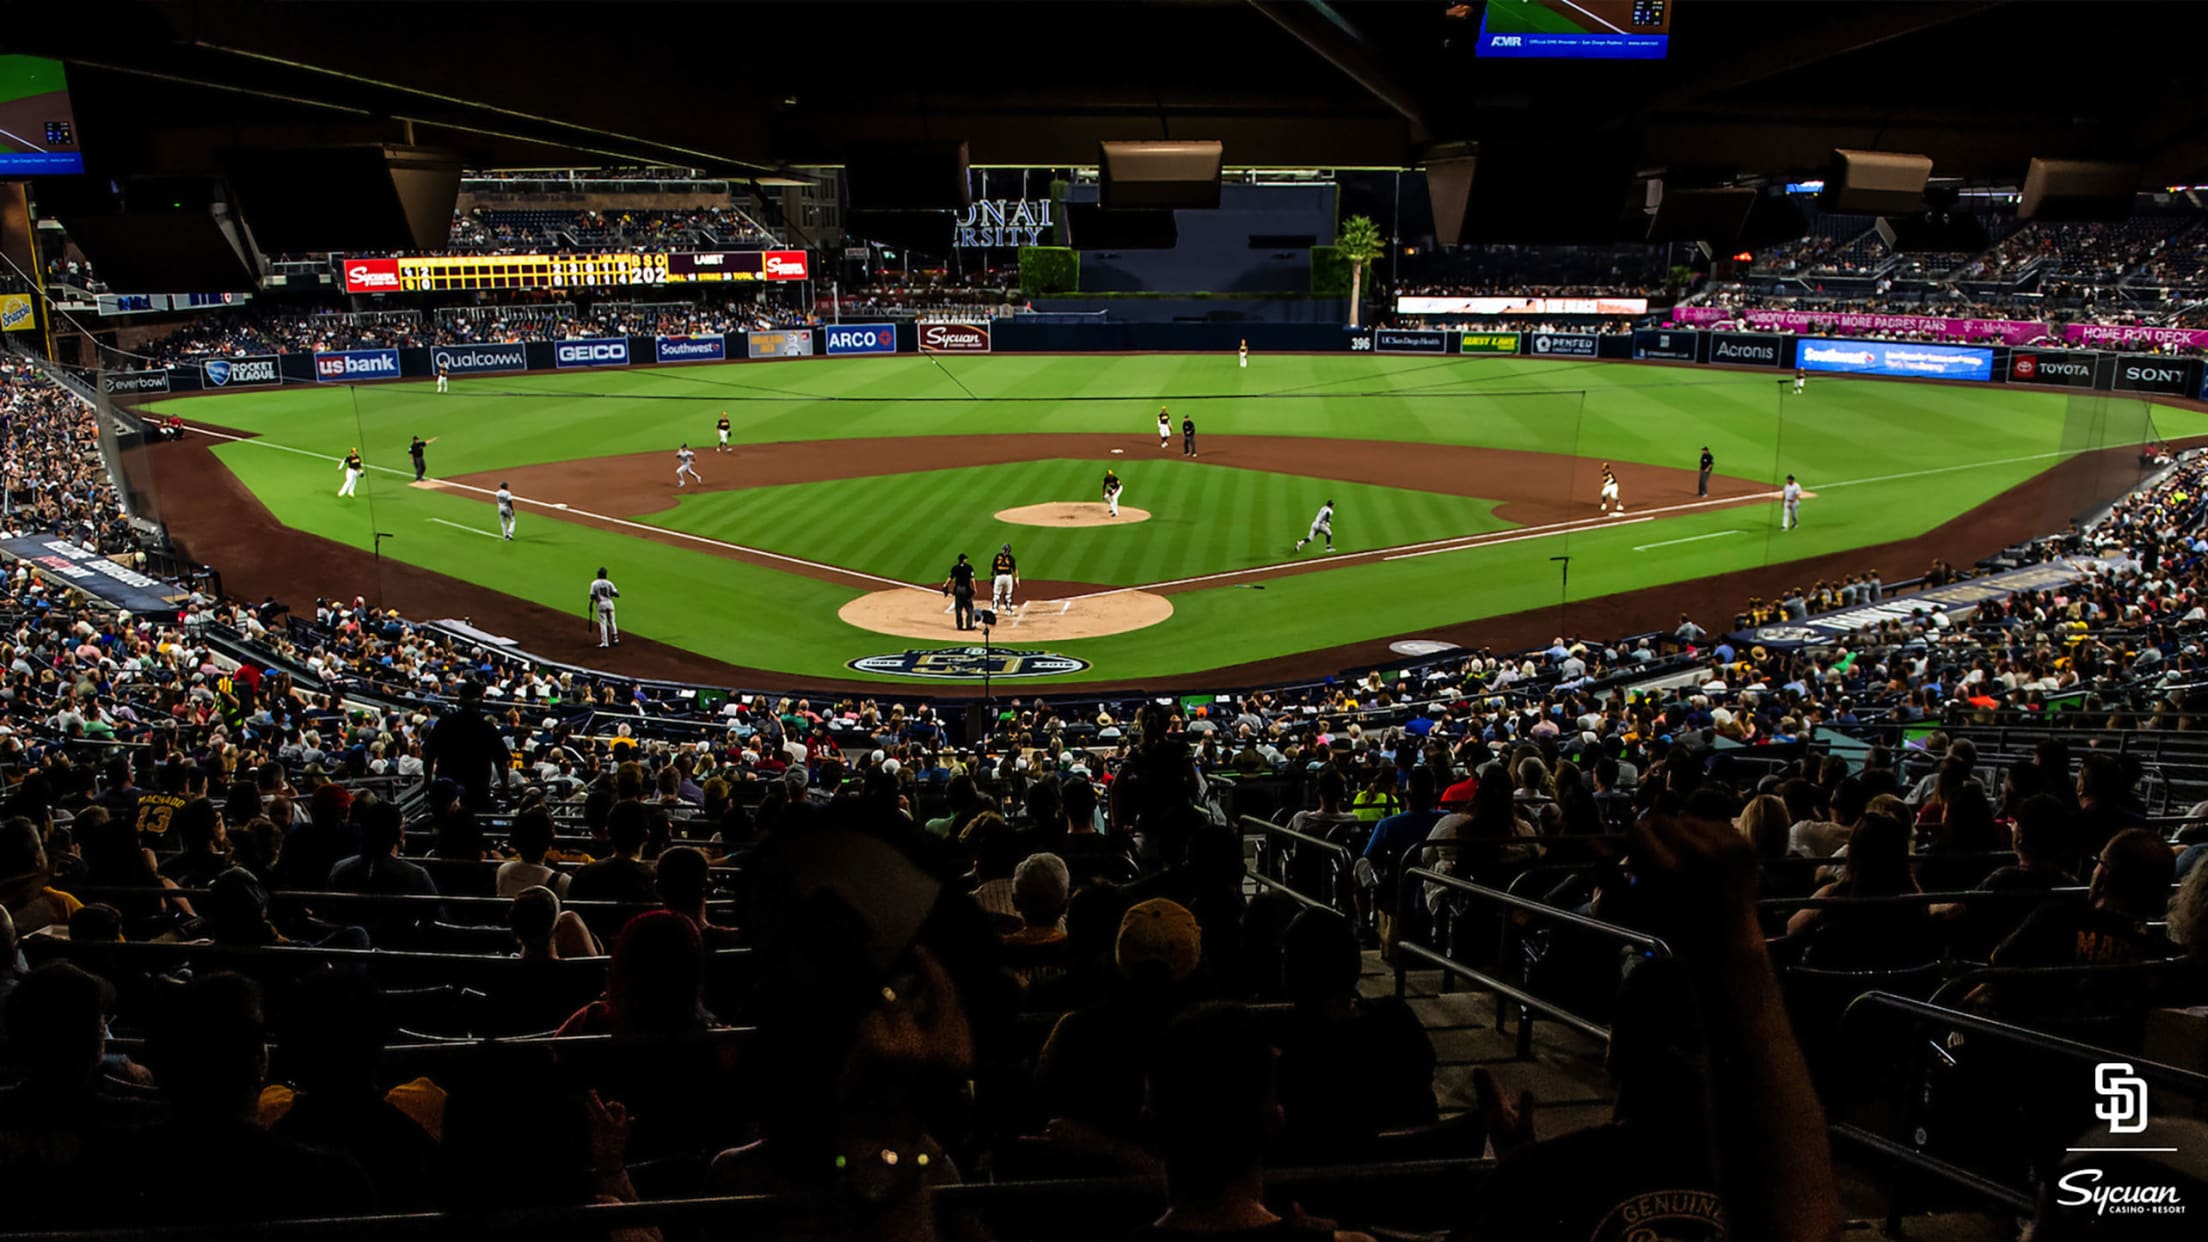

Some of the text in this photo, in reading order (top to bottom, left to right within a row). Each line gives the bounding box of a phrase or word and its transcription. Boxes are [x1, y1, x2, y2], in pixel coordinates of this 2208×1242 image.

[631, 255, 641, 267] B
[643, 254, 653, 267] S
[1842, 316, 1872, 328] MORE
[829, 331, 877, 348] ARCO
[926, 326, 980, 348] Sycuan
[2083, 327, 2121, 340] HOME
[2154, 331, 2193, 344] DECK
[661, 342, 713, 355] Southwest
[1351, 337, 1371, 350] 396
[1552, 338, 1593, 348] PENFED
[1716, 341, 1774, 359] Acronis
[435, 350, 523, 368] Qualcomm
[559, 344, 626, 362] GEICO
[232, 361, 274, 373] ROCKET
[2039, 362, 2090, 377] TOYOTA
[232, 370, 276, 382] LEAGUE
[2125, 366, 2185, 383] SONY
[115, 376, 167, 390] everbowl
[138, 795, 186, 808] MACHADO
[136, 805, 172, 833] 13
